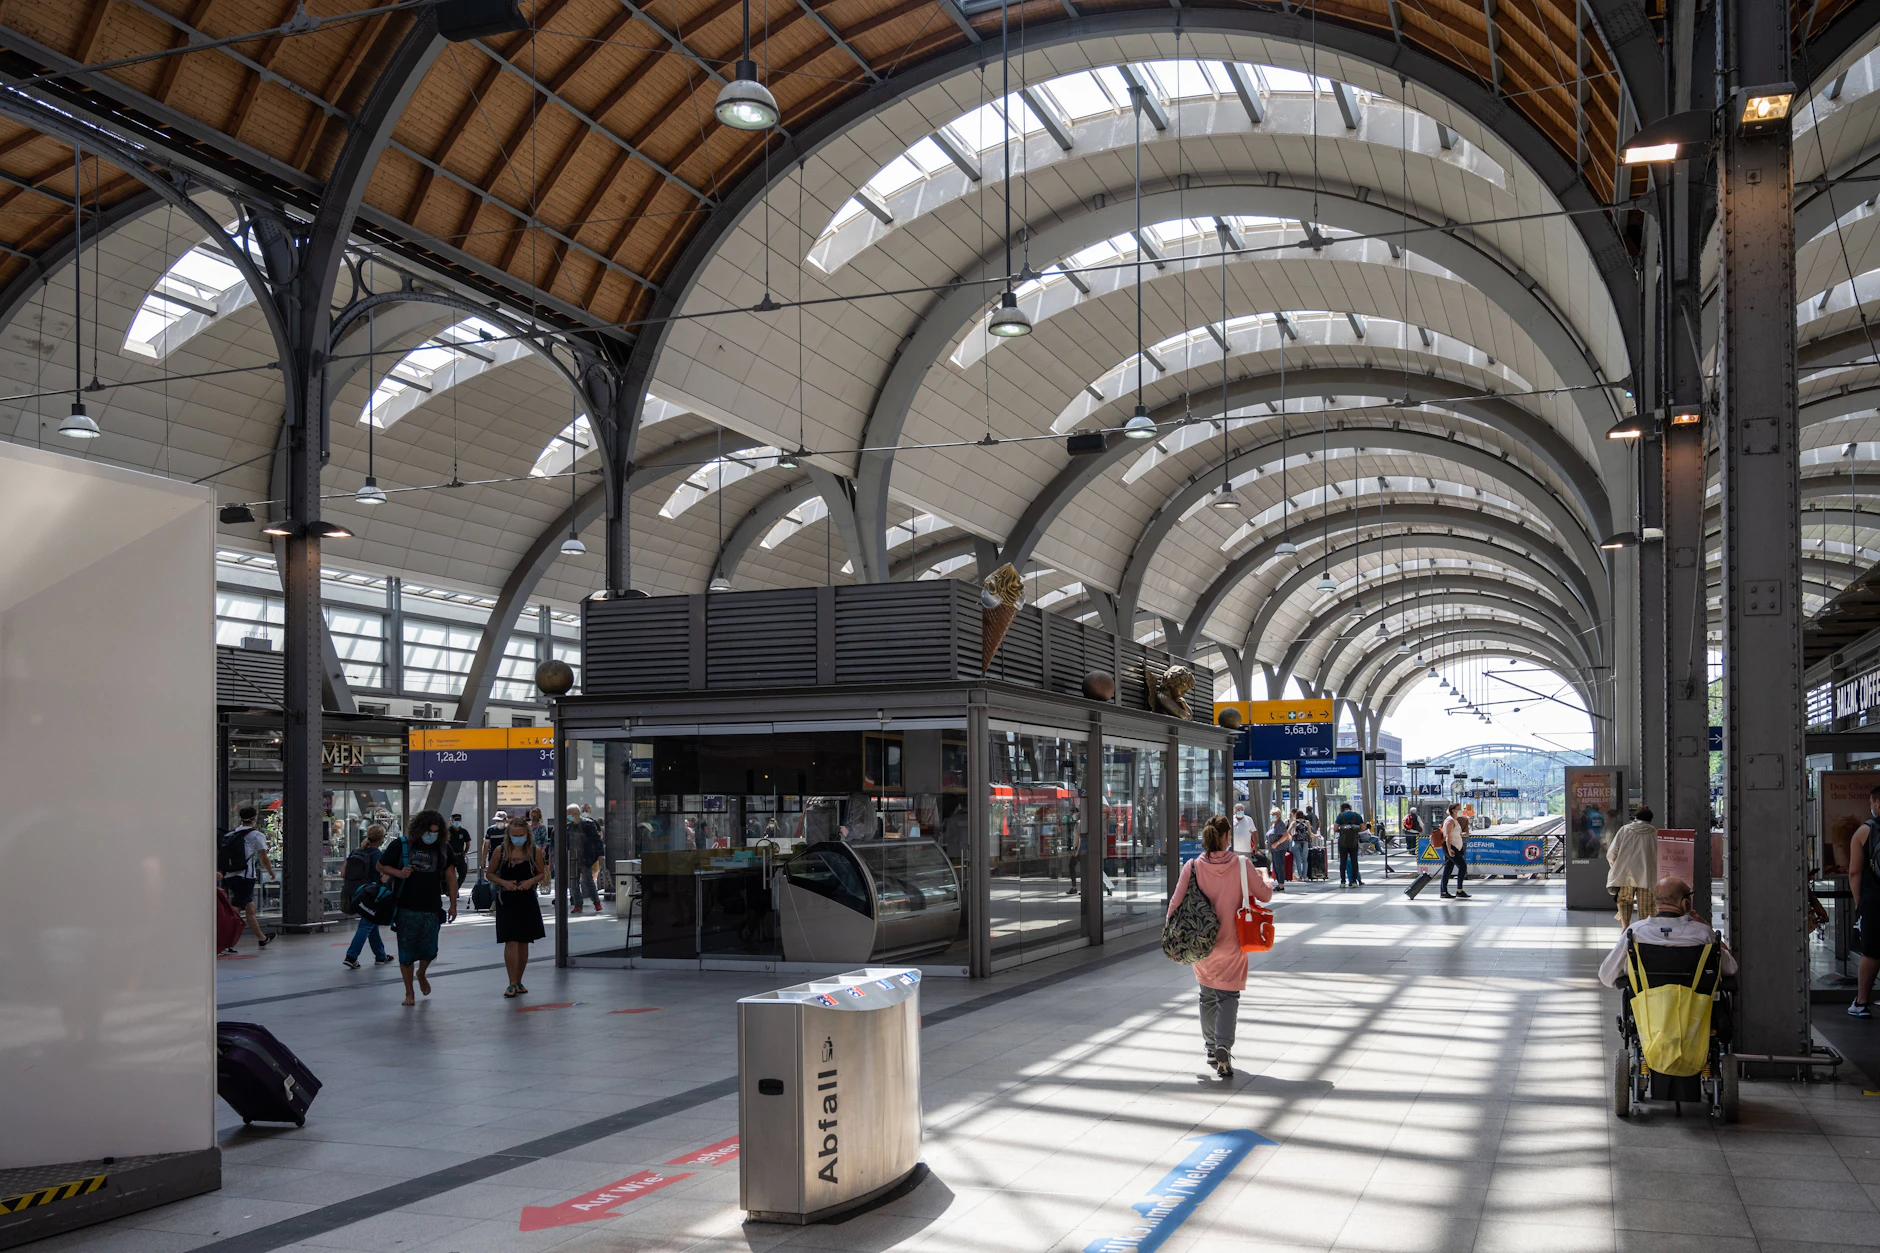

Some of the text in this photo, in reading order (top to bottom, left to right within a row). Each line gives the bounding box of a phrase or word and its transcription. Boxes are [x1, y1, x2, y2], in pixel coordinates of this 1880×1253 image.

[1836, 680, 1859, 718] BALZAC
[1284, 725, 1319, 735] 5,6a,6b
[321, 744, 365, 765] MEN
[436, 751, 468, 763] 1,2a,2b
[1385, 785, 1403, 793] 3 A
[1421, 785, 1440, 793] A 4
[818, 1068, 839, 1184] Abfall
[1170, 1148, 1233, 1188] Welcome
[571, 1193, 621, 1212] Auf
